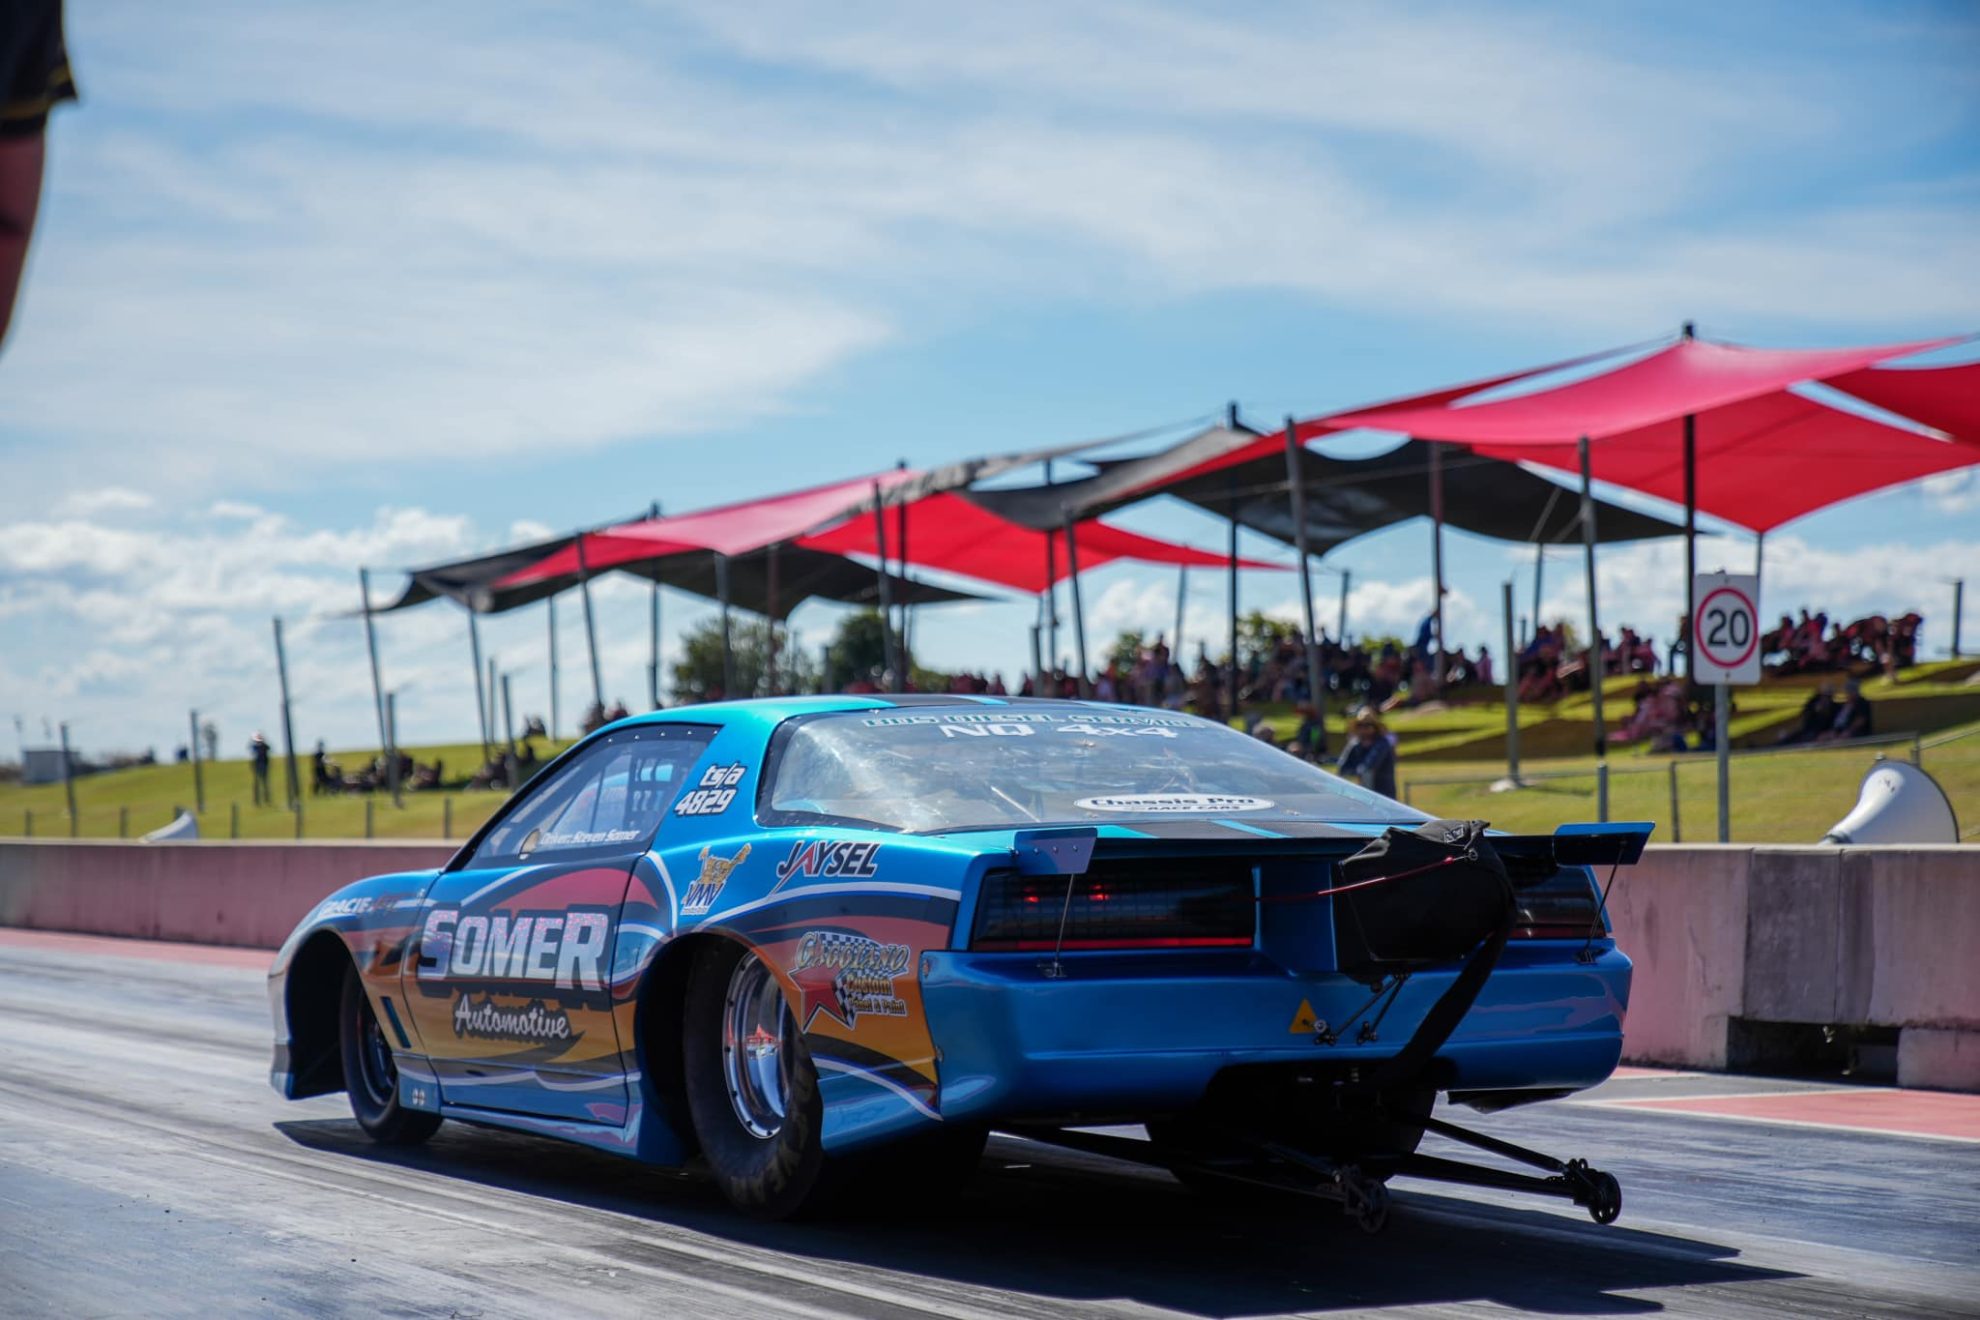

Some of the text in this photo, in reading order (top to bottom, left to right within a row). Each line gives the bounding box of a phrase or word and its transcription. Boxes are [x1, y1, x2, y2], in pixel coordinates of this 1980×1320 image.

[1707, 609, 1750, 648] 20
[938, 723, 1179, 738] NQ 4x4
[699, 761, 747, 788] ts/a
[674, 788, 738, 816] 4829
[1091, 798, 1199, 806] Chassis
[774, 840, 881, 881] JAYSEL
[417, 909, 609, 991] SOMER
[455, 994, 570, 1039] Automotive
